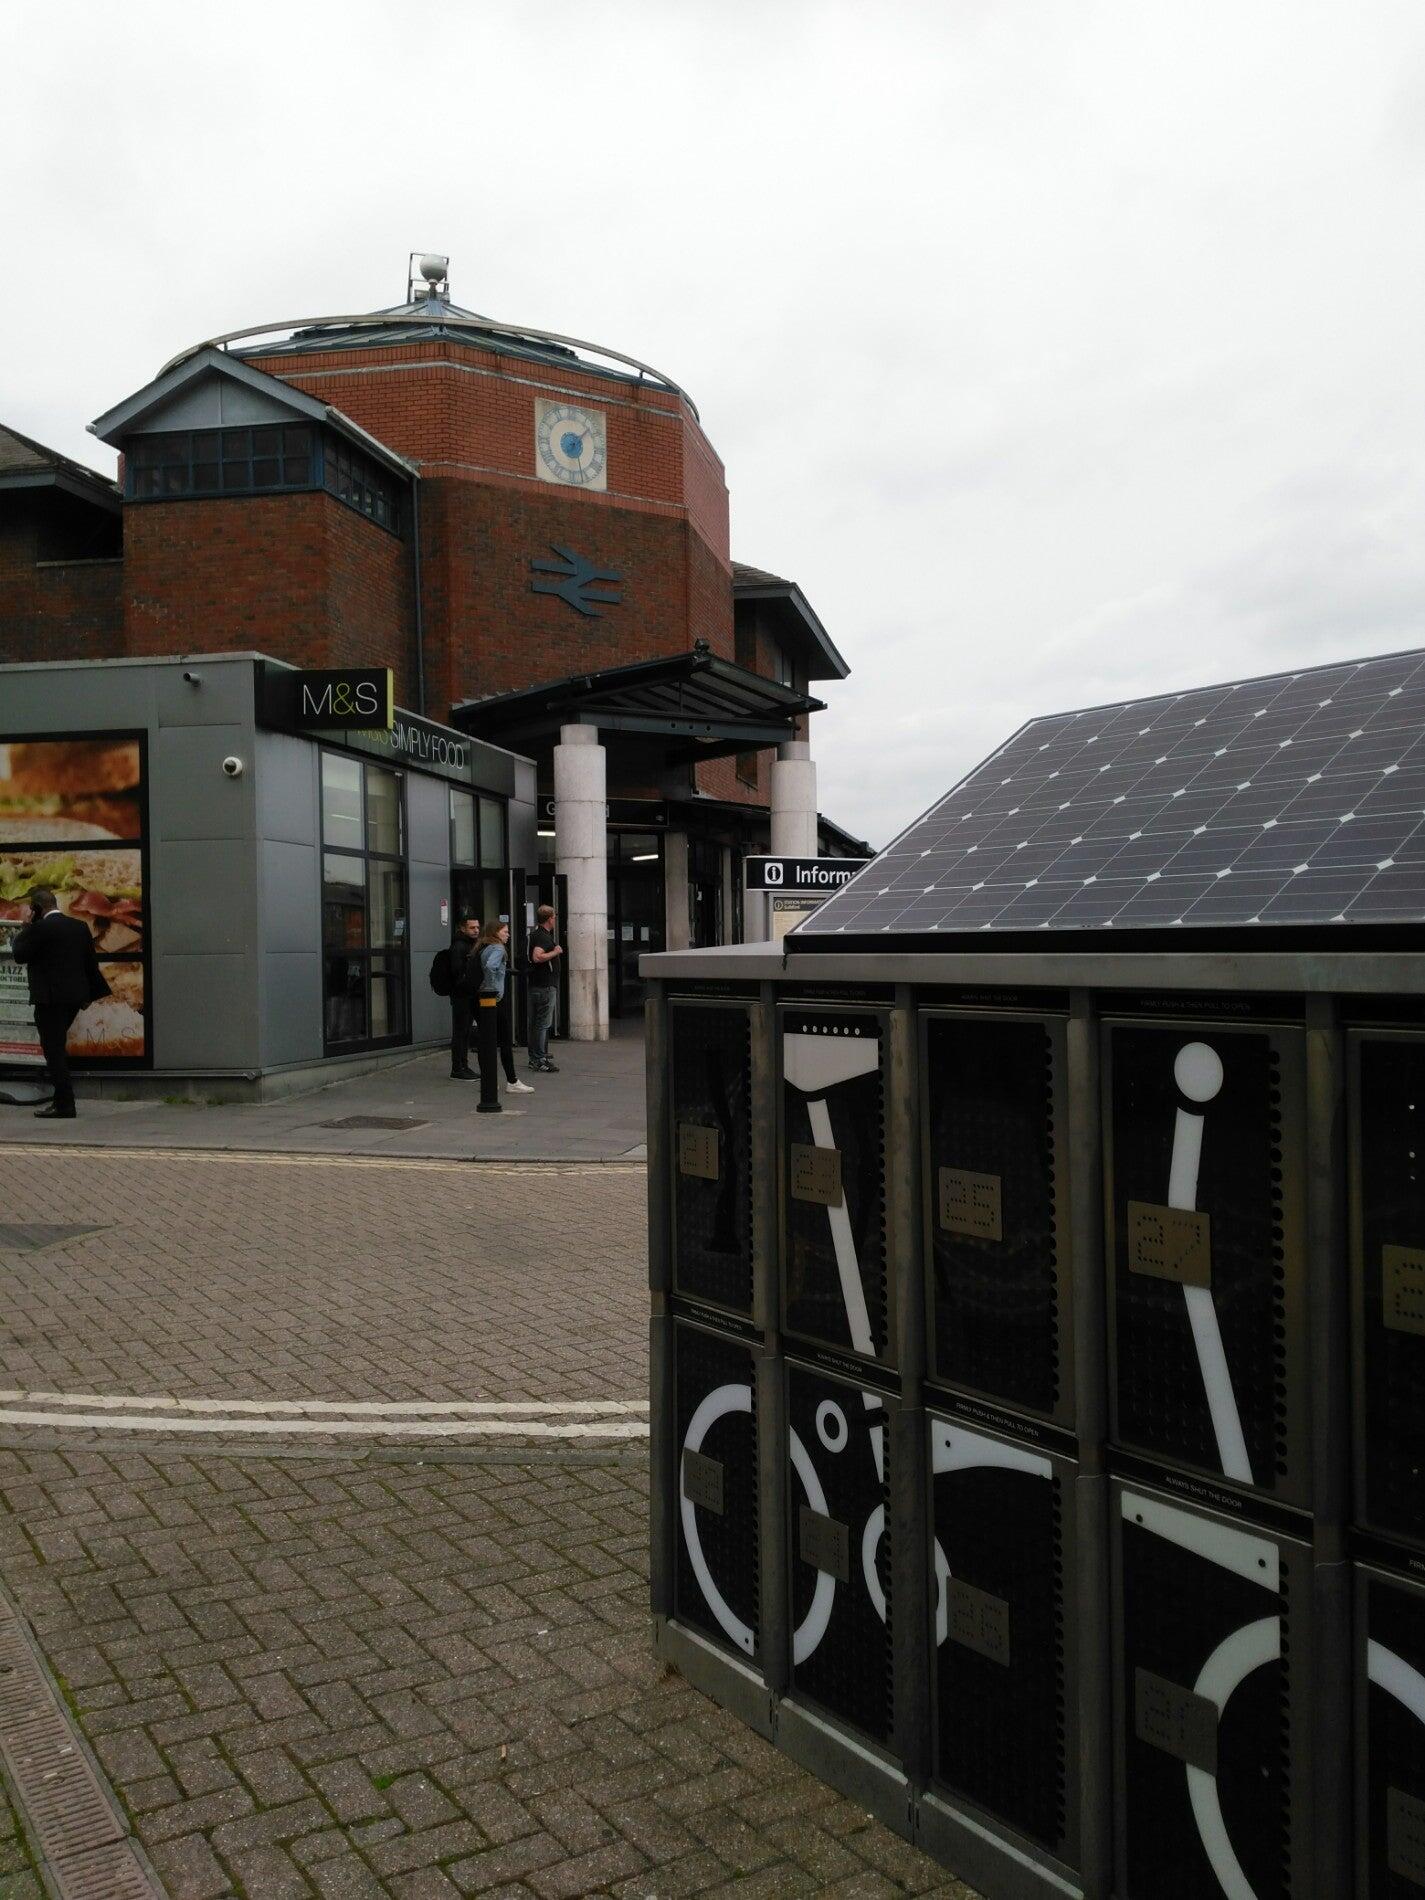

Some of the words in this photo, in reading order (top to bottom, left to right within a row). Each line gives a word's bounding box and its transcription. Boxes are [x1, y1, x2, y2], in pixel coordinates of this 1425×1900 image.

[303, 682, 378, 716] M&S
[391, 721, 432, 759] SIMPLY
[432, 734, 465, 770] FOOD
[796, 865, 857, 885] Inform
[0, 975, 27, 983] OCTOBE
[945, 1180, 994, 1226] 25
[1137, 1216, 1200, 1269] 27
